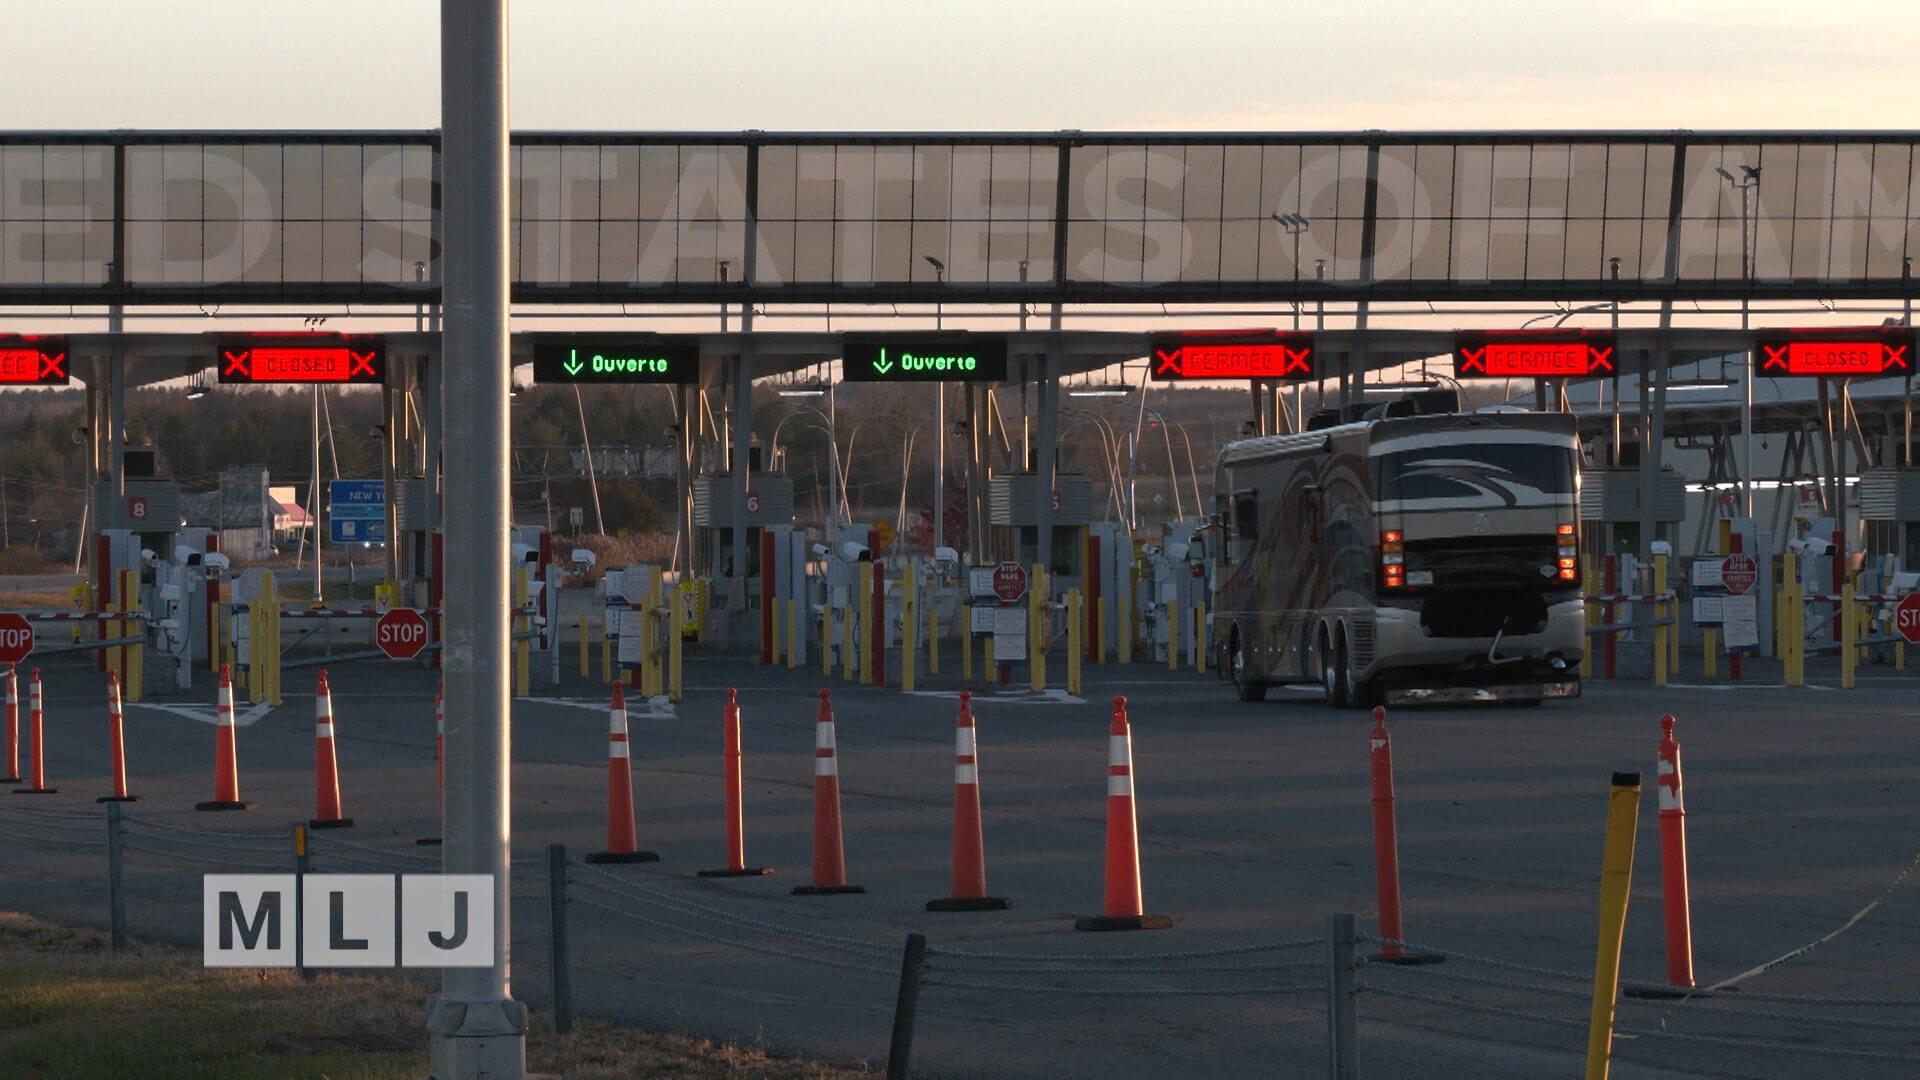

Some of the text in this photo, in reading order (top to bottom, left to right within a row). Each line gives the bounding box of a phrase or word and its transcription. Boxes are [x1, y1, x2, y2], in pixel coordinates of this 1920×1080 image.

[355, 148, 1193, 288] STATES
[1276, 149, 1575, 288] OF
[267, 357, 336, 373] CLOSED
[592, 355, 668, 373] Ouverte
[902, 354, 976, 371] Ouverte
[1804, 351, 1869, 367] CLOSED
[350, 491, 372, 500] NEW
[747, 496, 759, 511] 6
[380, 623, 424, 642] STOP
